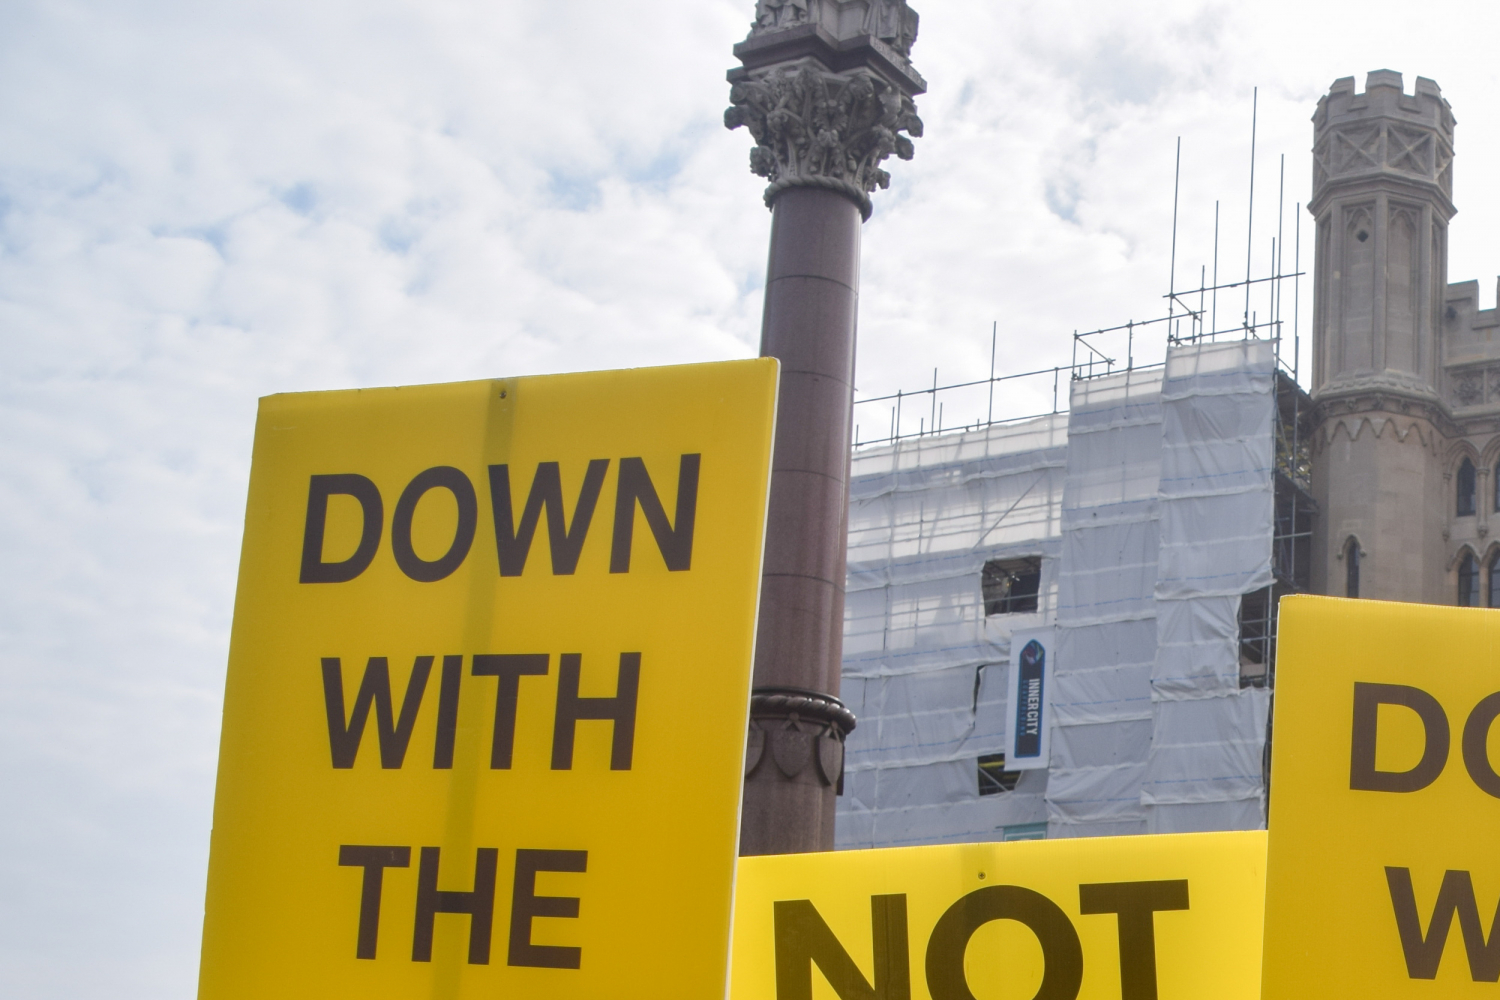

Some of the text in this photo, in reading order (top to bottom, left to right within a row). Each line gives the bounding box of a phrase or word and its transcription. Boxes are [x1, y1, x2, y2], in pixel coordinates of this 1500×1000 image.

[299, 453, 701, 584] DOWN
[321, 652, 642, 771] WITH
[339, 845, 589, 970] THE
